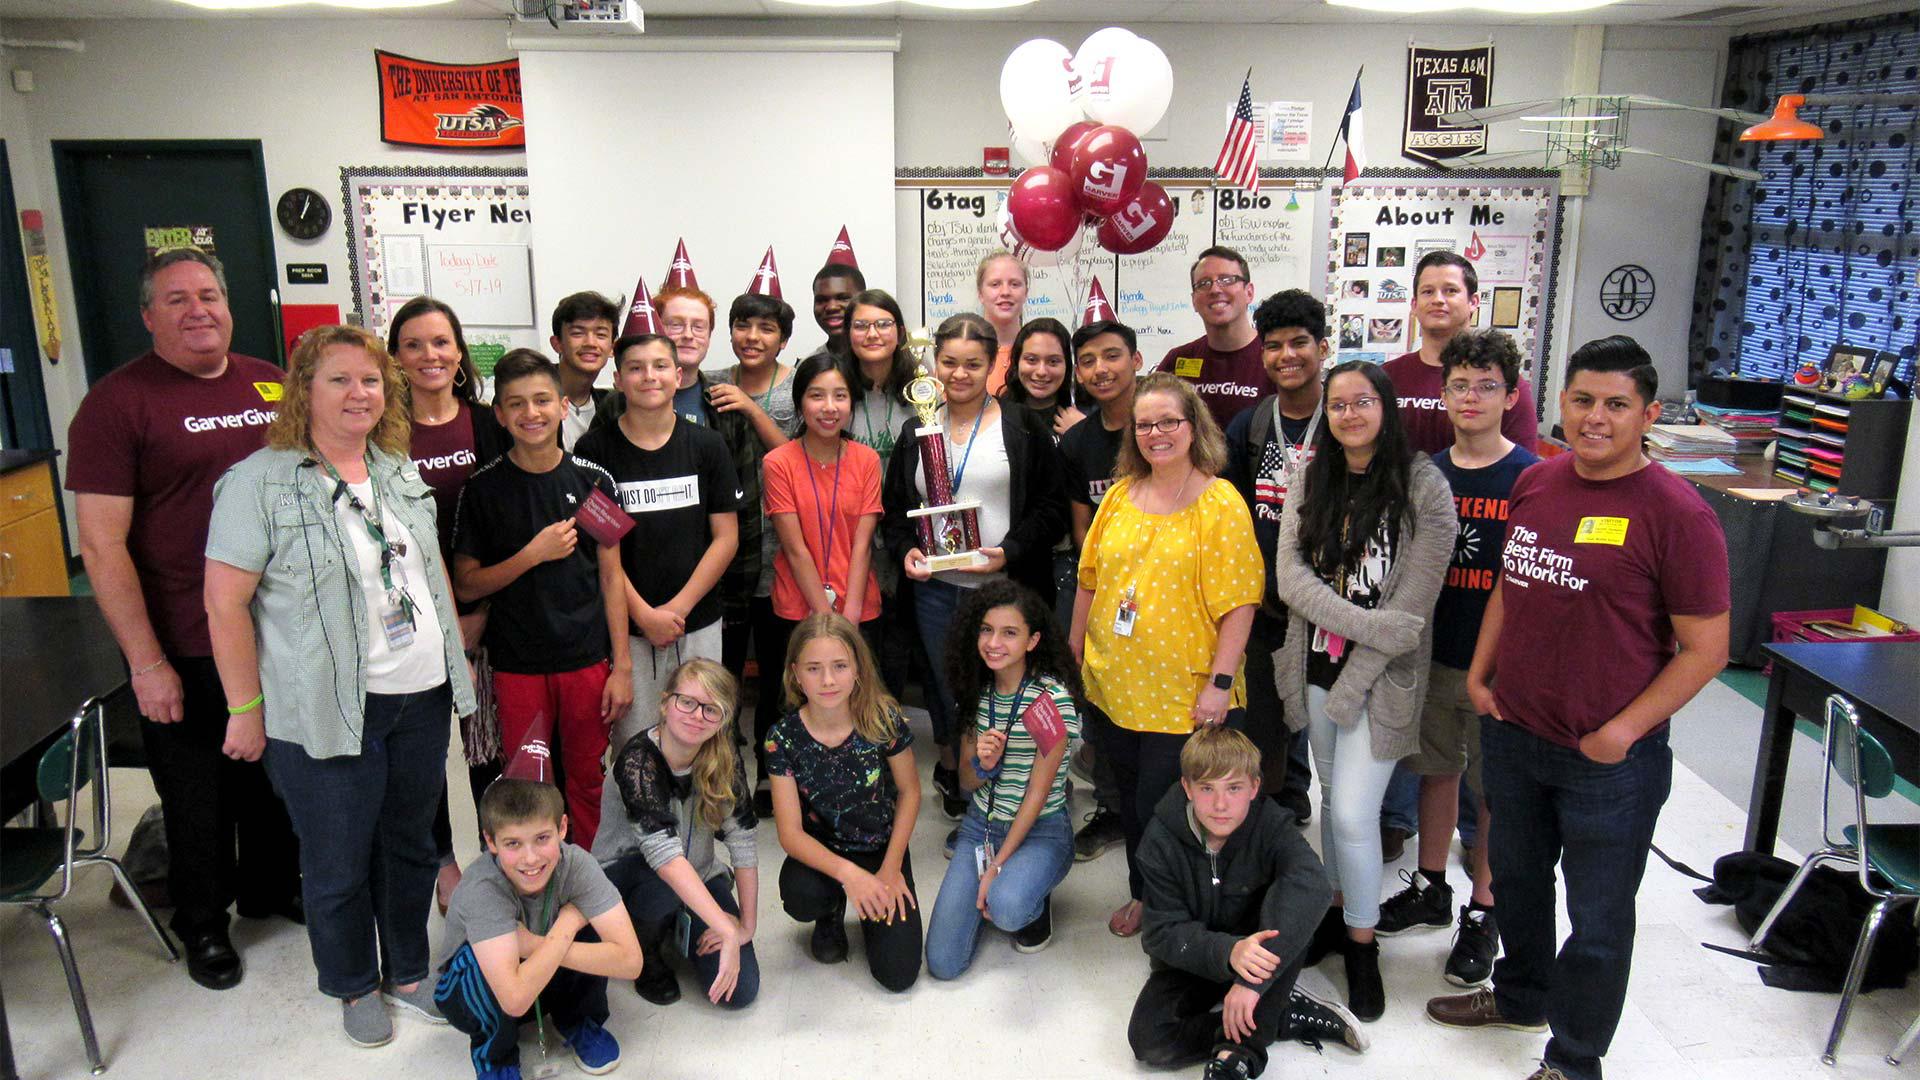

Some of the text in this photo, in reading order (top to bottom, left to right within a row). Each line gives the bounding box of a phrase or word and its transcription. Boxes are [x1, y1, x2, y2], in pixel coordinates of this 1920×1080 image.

[1415, 56, 1486, 77] TEXAS A&M
[388, 64, 523, 99] THE UNIVERSITY OF TE
[413, 94, 430, 103] AT
[433, 92, 460, 101] SAN
[440, 115, 497, 132] UTSA
[1411, 132, 1481, 147] AGGIES
[1085, 185, 1120, 200] GARVER
[1219, 189, 1271, 211] 8bio
[927, 189, 985, 218] 6tag
[402, 202, 476, 231] Flyer
[1375, 205, 1505, 227] About Me
[146, 227, 192, 248] ENTER
[195, 227, 209, 237] AT
[1113, 214, 1135, 242] GARVER
[192, 236, 213, 245] YOUR
[1191, 381, 1258, 398] rverGives
[184, 408, 279, 433] GarverGive
[644, 488, 657, 504] DO
[1511, 525, 1538, 544] The
[1504, 540, 1573, 571] Best Firm
[1446, 566, 1493, 591] DING
[1502, 554, 1588, 592] To Work For
